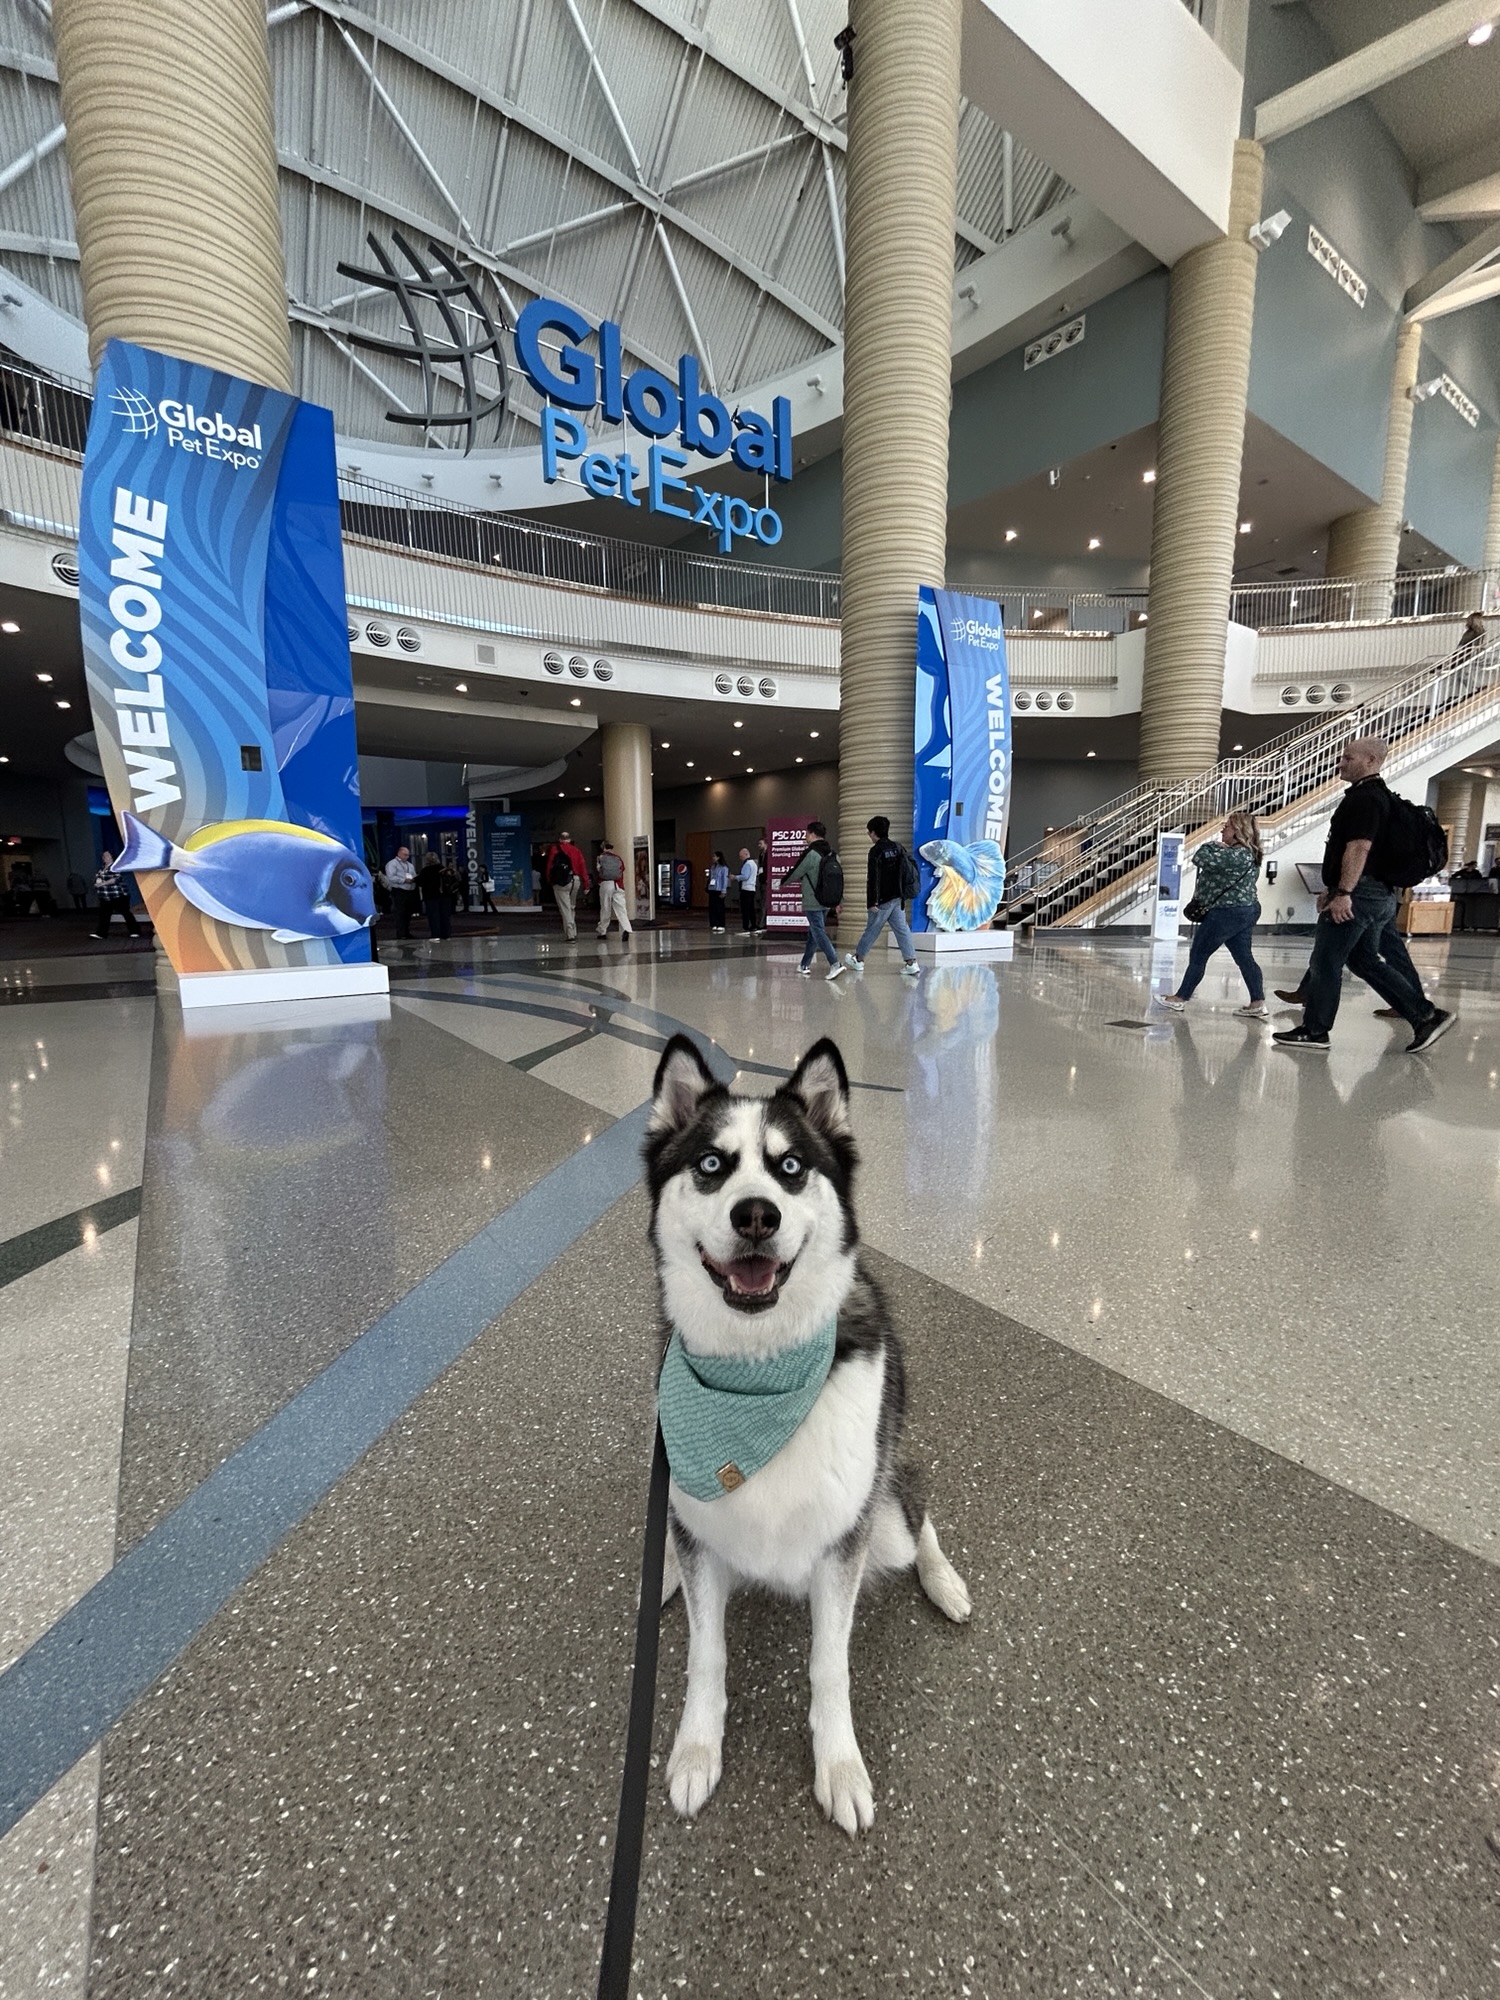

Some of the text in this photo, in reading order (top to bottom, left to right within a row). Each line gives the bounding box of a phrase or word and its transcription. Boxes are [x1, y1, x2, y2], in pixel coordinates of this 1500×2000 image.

[514, 297, 792, 481] Global
[158, 399, 263, 450] Global
[168, 427, 260, 470] Pet Expo
[540, 405, 783, 553] Pet Expo
[109, 486, 182, 813] WELCOME
[966, 619, 1001, 640] Global
[967, 634, 999, 652] Pet Expo
[984, 672, 1006, 841] WELCOME
[465, 809, 479, 896] WELCOME
[772, 830, 807, 841] PSC 202
[679, 878, 687, 903] pepsi
